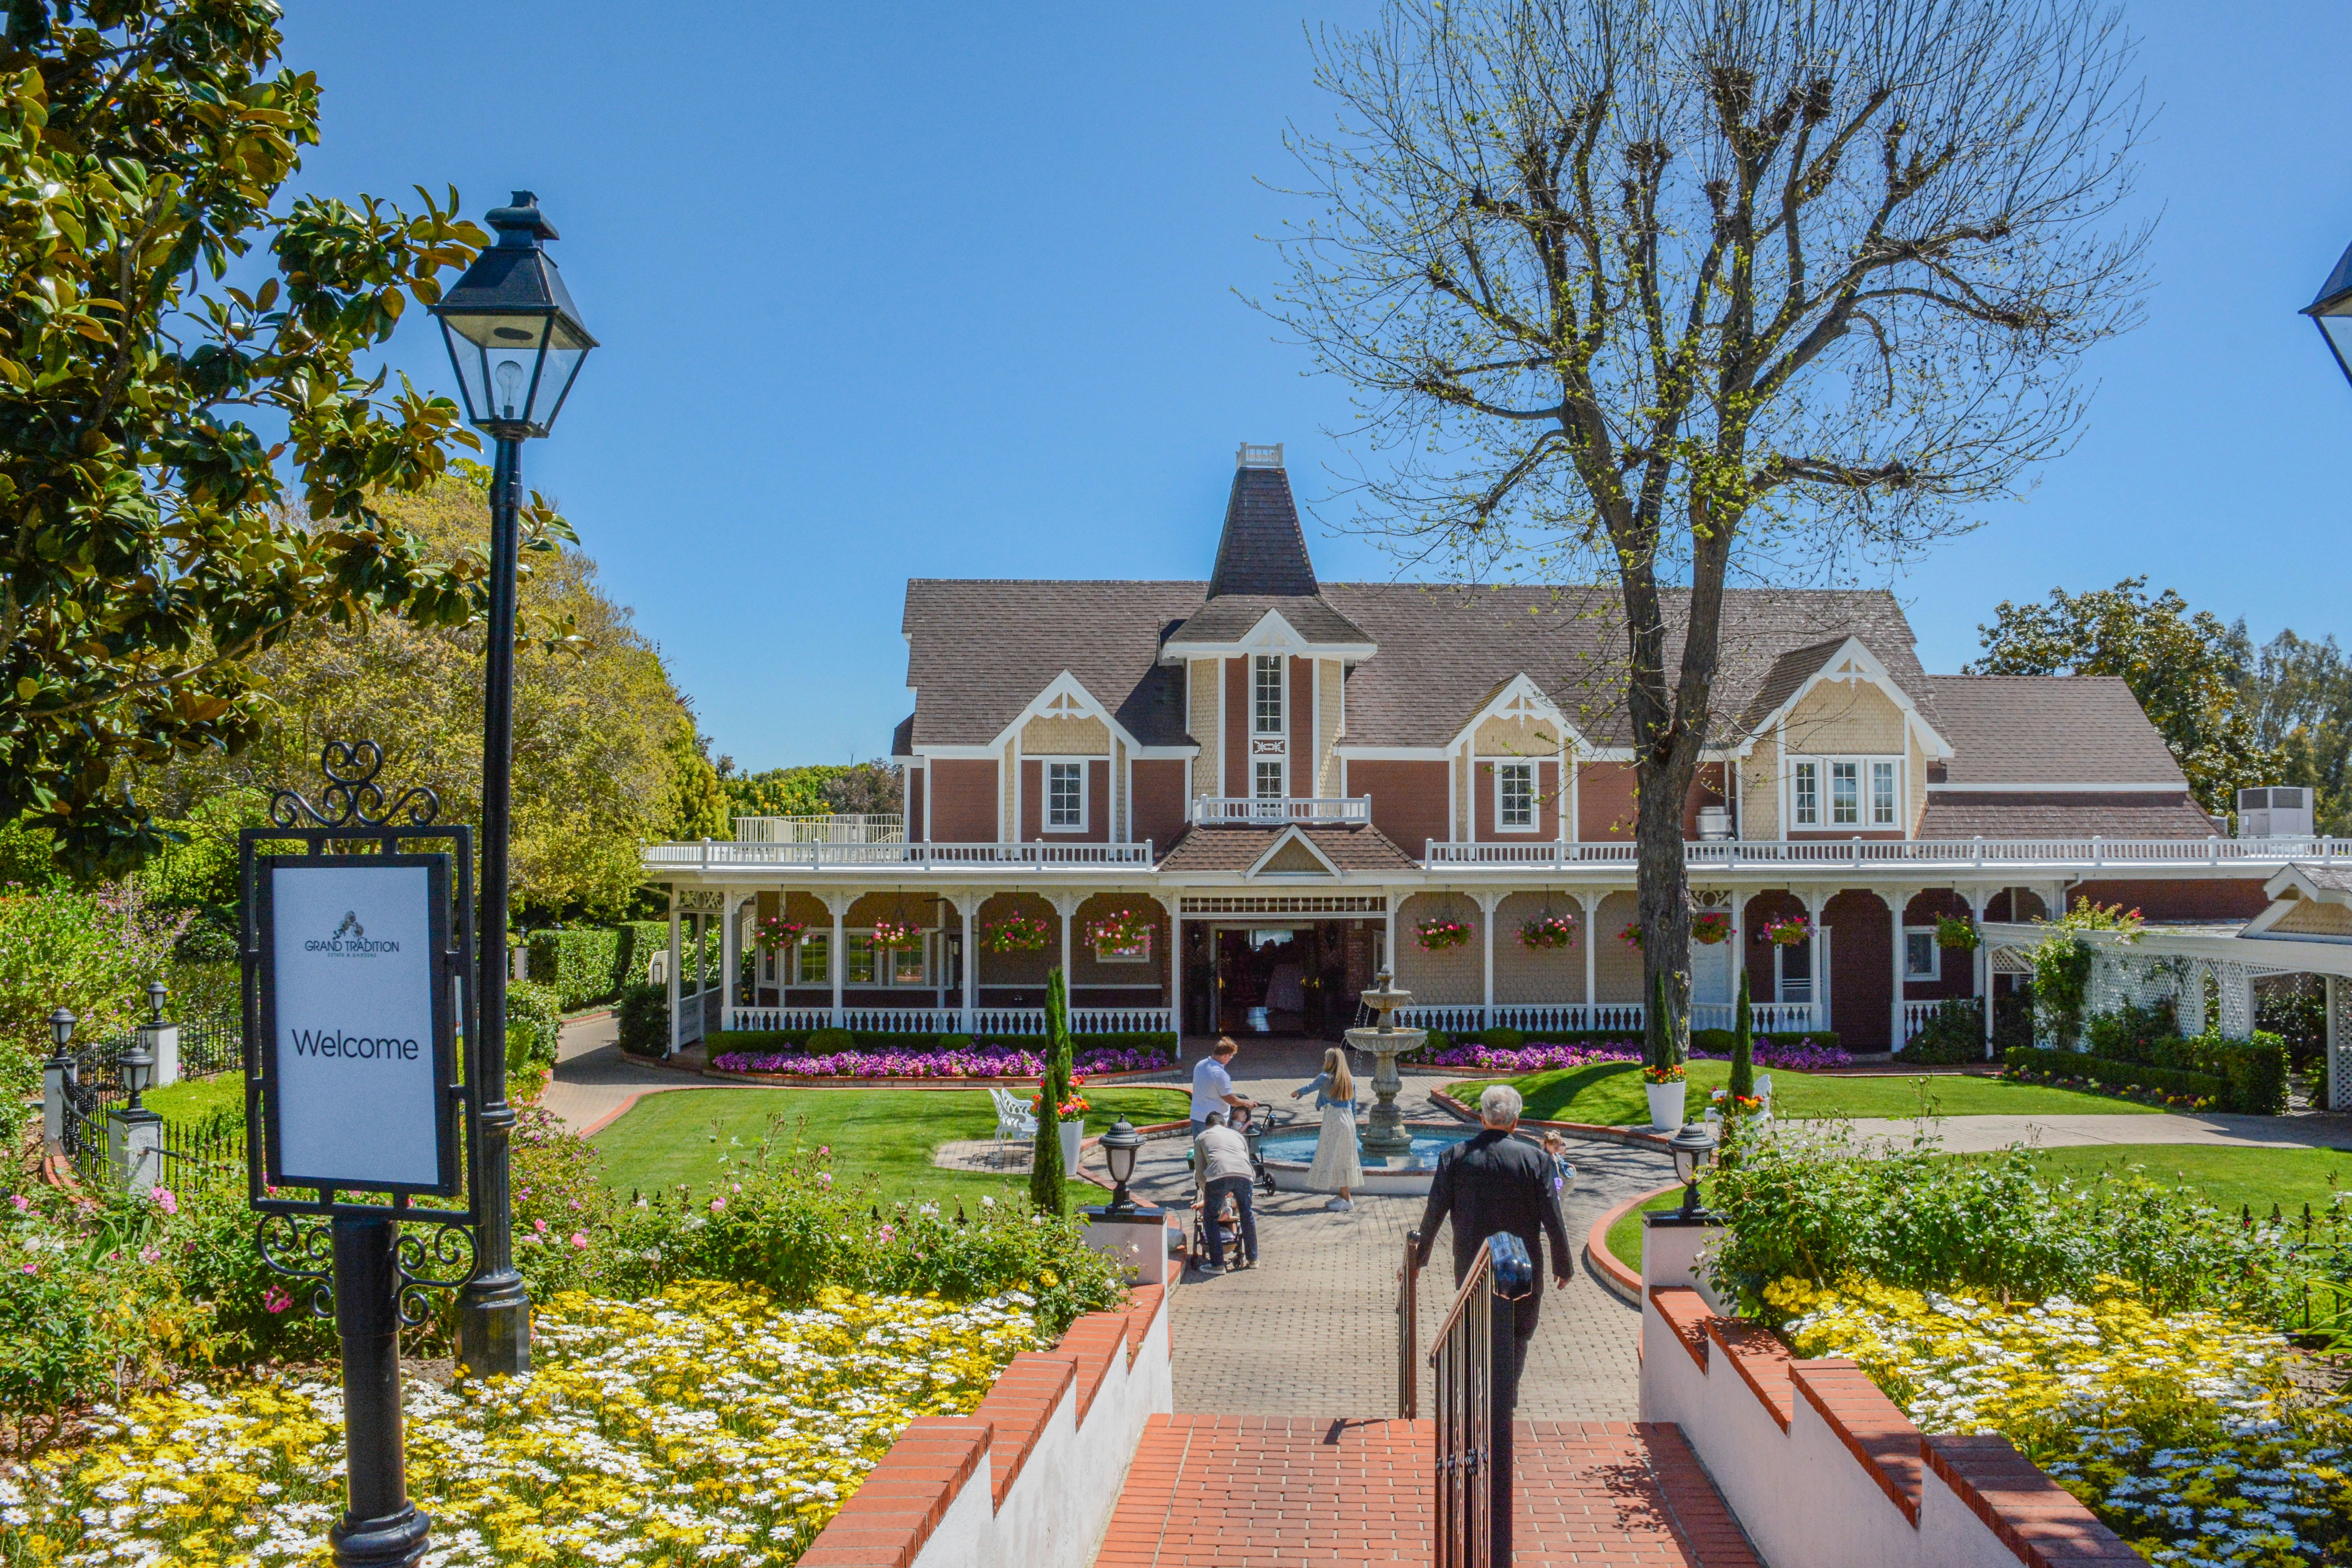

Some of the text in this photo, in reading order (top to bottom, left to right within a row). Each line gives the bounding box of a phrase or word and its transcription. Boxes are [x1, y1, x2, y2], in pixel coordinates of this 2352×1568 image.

[305, 940, 399, 952] GRAND TRADITION
[292, 1029, 418, 1060] Welcome
